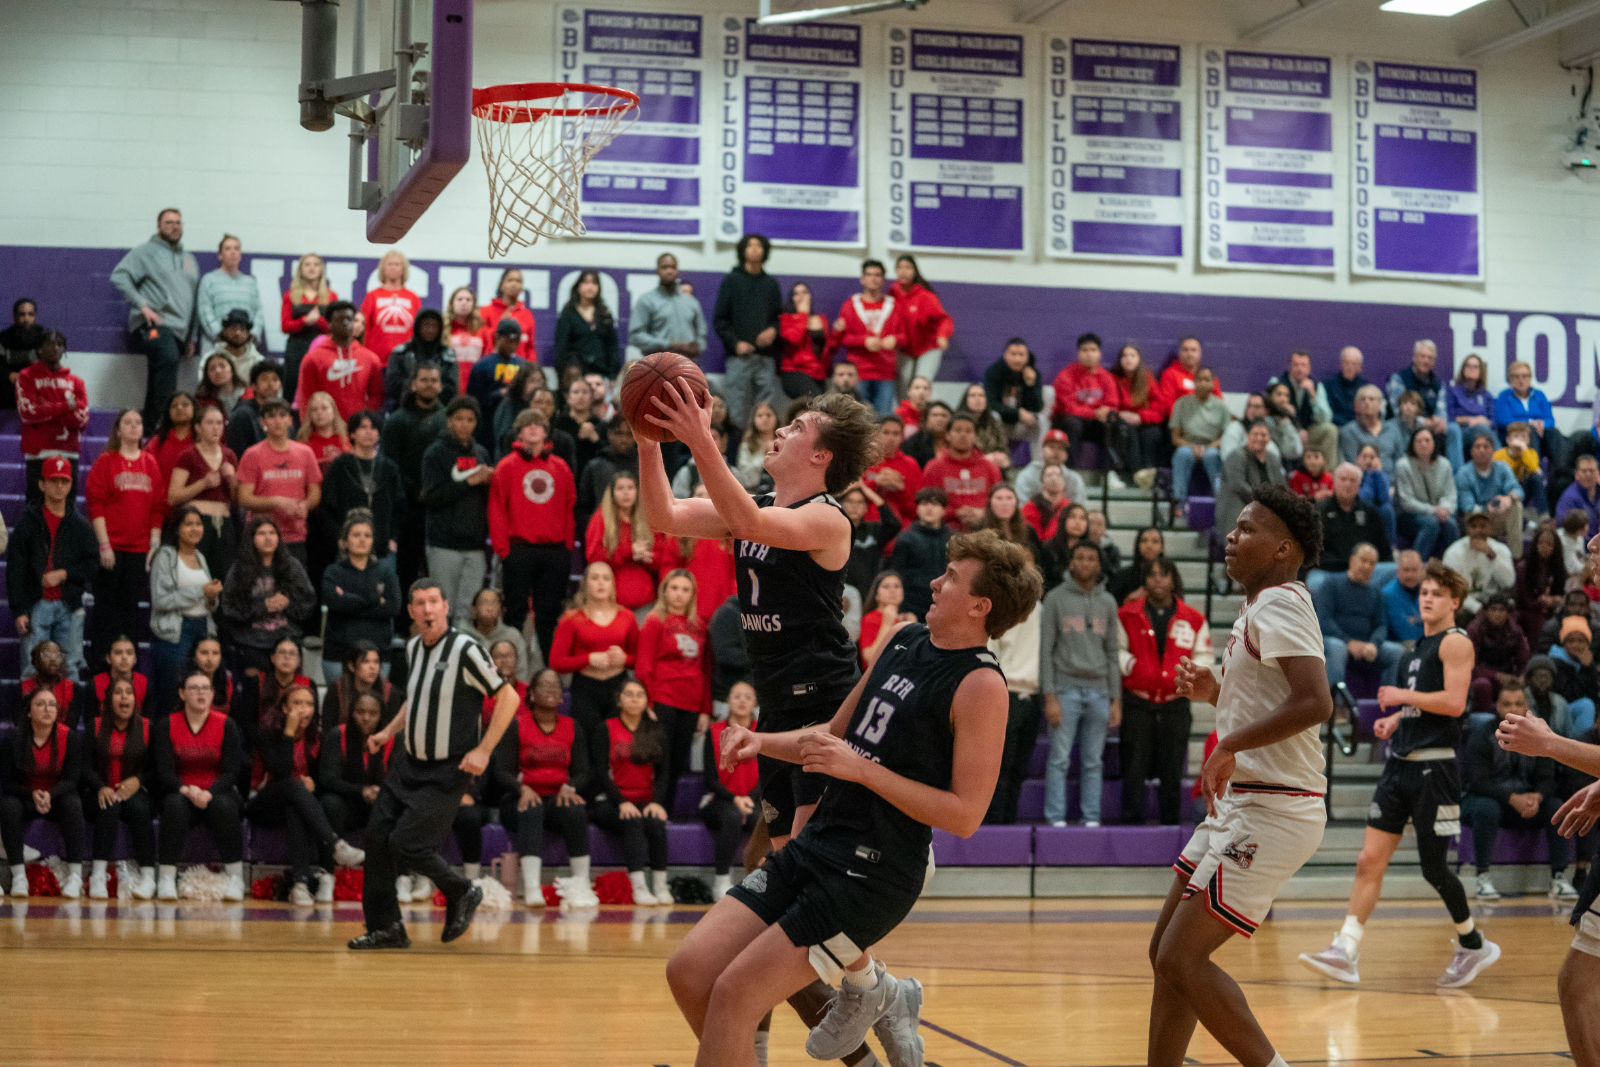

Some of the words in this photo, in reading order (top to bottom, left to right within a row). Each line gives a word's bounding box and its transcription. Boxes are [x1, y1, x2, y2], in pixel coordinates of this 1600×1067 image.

[721, 35, 739, 217] BULLDOGS
[889, 46, 905, 226] BULLDOGS
[1051, 56, 1066, 233] BULLDOGS
[1205, 67, 1221, 242] BULLDOGS
[1355, 78, 1370, 251] BULLDOGS
[740, 540, 771, 561] RFH
[747, 567, 760, 607] 1
[740, 612, 782, 632] DAWGS
[854, 695, 896, 745] 13
[881, 674, 915, 701] RFH
